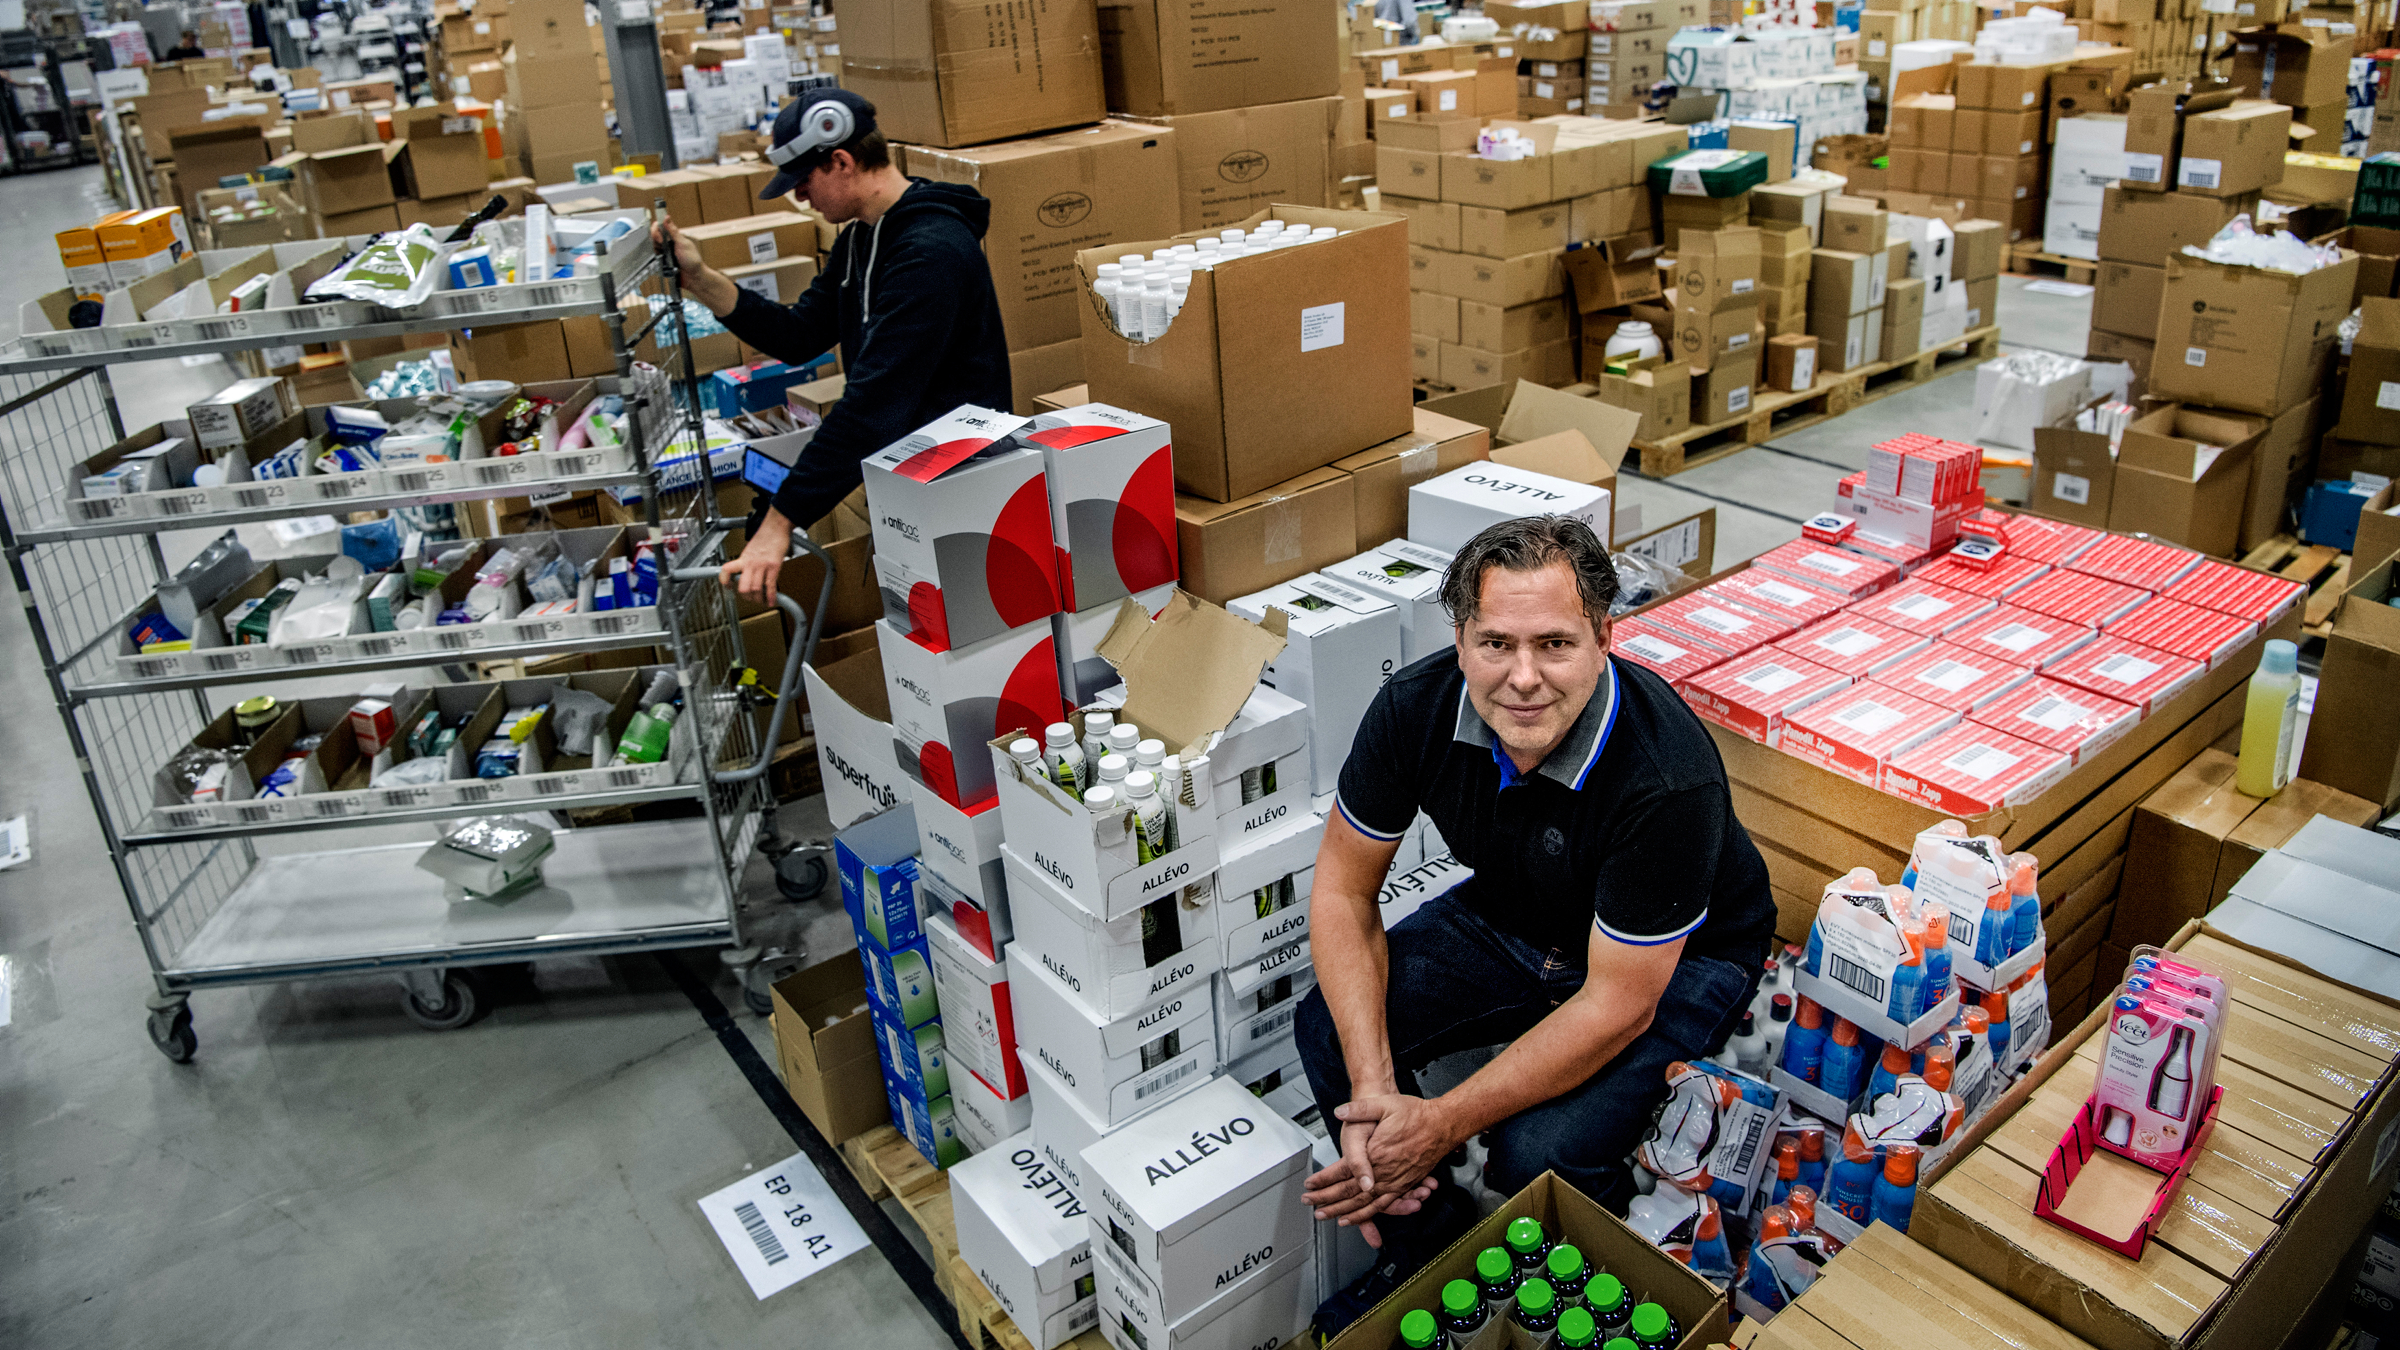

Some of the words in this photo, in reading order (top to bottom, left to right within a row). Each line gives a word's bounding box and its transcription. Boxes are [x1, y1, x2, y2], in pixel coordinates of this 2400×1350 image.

[480, 291, 498, 303] 16
[154, 326, 171, 338] 12
[229, 319, 248, 330] 13
[429, 469, 445, 481] 25
[509, 462, 527, 474] 26
[267, 486, 284, 497] 23
[1463, 474, 1566, 502] ALLÉVO
[888, 516, 919, 538] antibac
[1357, 570, 1399, 586] ALLÉVO
[1683, 685, 1711, 706] Panodil
[1712, 698, 1730, 715] Zapp
[1783, 723, 1814, 747] Panodil
[1816, 737, 1836, 757] Zapp
[1886, 768, 1918, 792] Panodil
[1920, 783, 1942, 804] Zapp
[1243, 804, 1287, 833] ALLÉVO
[1035, 851, 1074, 890] ALLÉVO
[1142, 862, 1190, 893] ALLÉVO
[1260, 914, 1305, 944] ALLÉVO
[1830, 922, 1841, 930] EVY
[1042, 953, 1081, 993] ALLÉVO
[1258, 944, 1301, 975] ALLÉVO
[1150, 963, 1194, 995] ALLÉVO
[1137, 1000, 1183, 1031] ALLÉVO
[2118, 1019, 2148, 1039] Veet
[1039, 1047, 1076, 1088] ALLÉVO
[2111, 1045, 2145, 1063] Sensitive
[1044, 1144, 1080, 1188] ALLÉVO
[1144, 1116, 1255, 1187] ALLÉVO
[1010, 1148, 1087, 1220] ALLÉVO
[764, 1174, 792, 1196] EP
[784, 1204, 813, 1228] 18
[803, 1234, 834, 1260] A1
[1101, 1188, 1135, 1227] ALLÉVO
[1836, 1199, 1865, 1220] 30
[1214, 1245, 1273, 1290] ALLÉVO
[980, 1268, 1014, 1314] ALLÉVO
[1114, 1285, 1149, 1325] ALLÉVO
